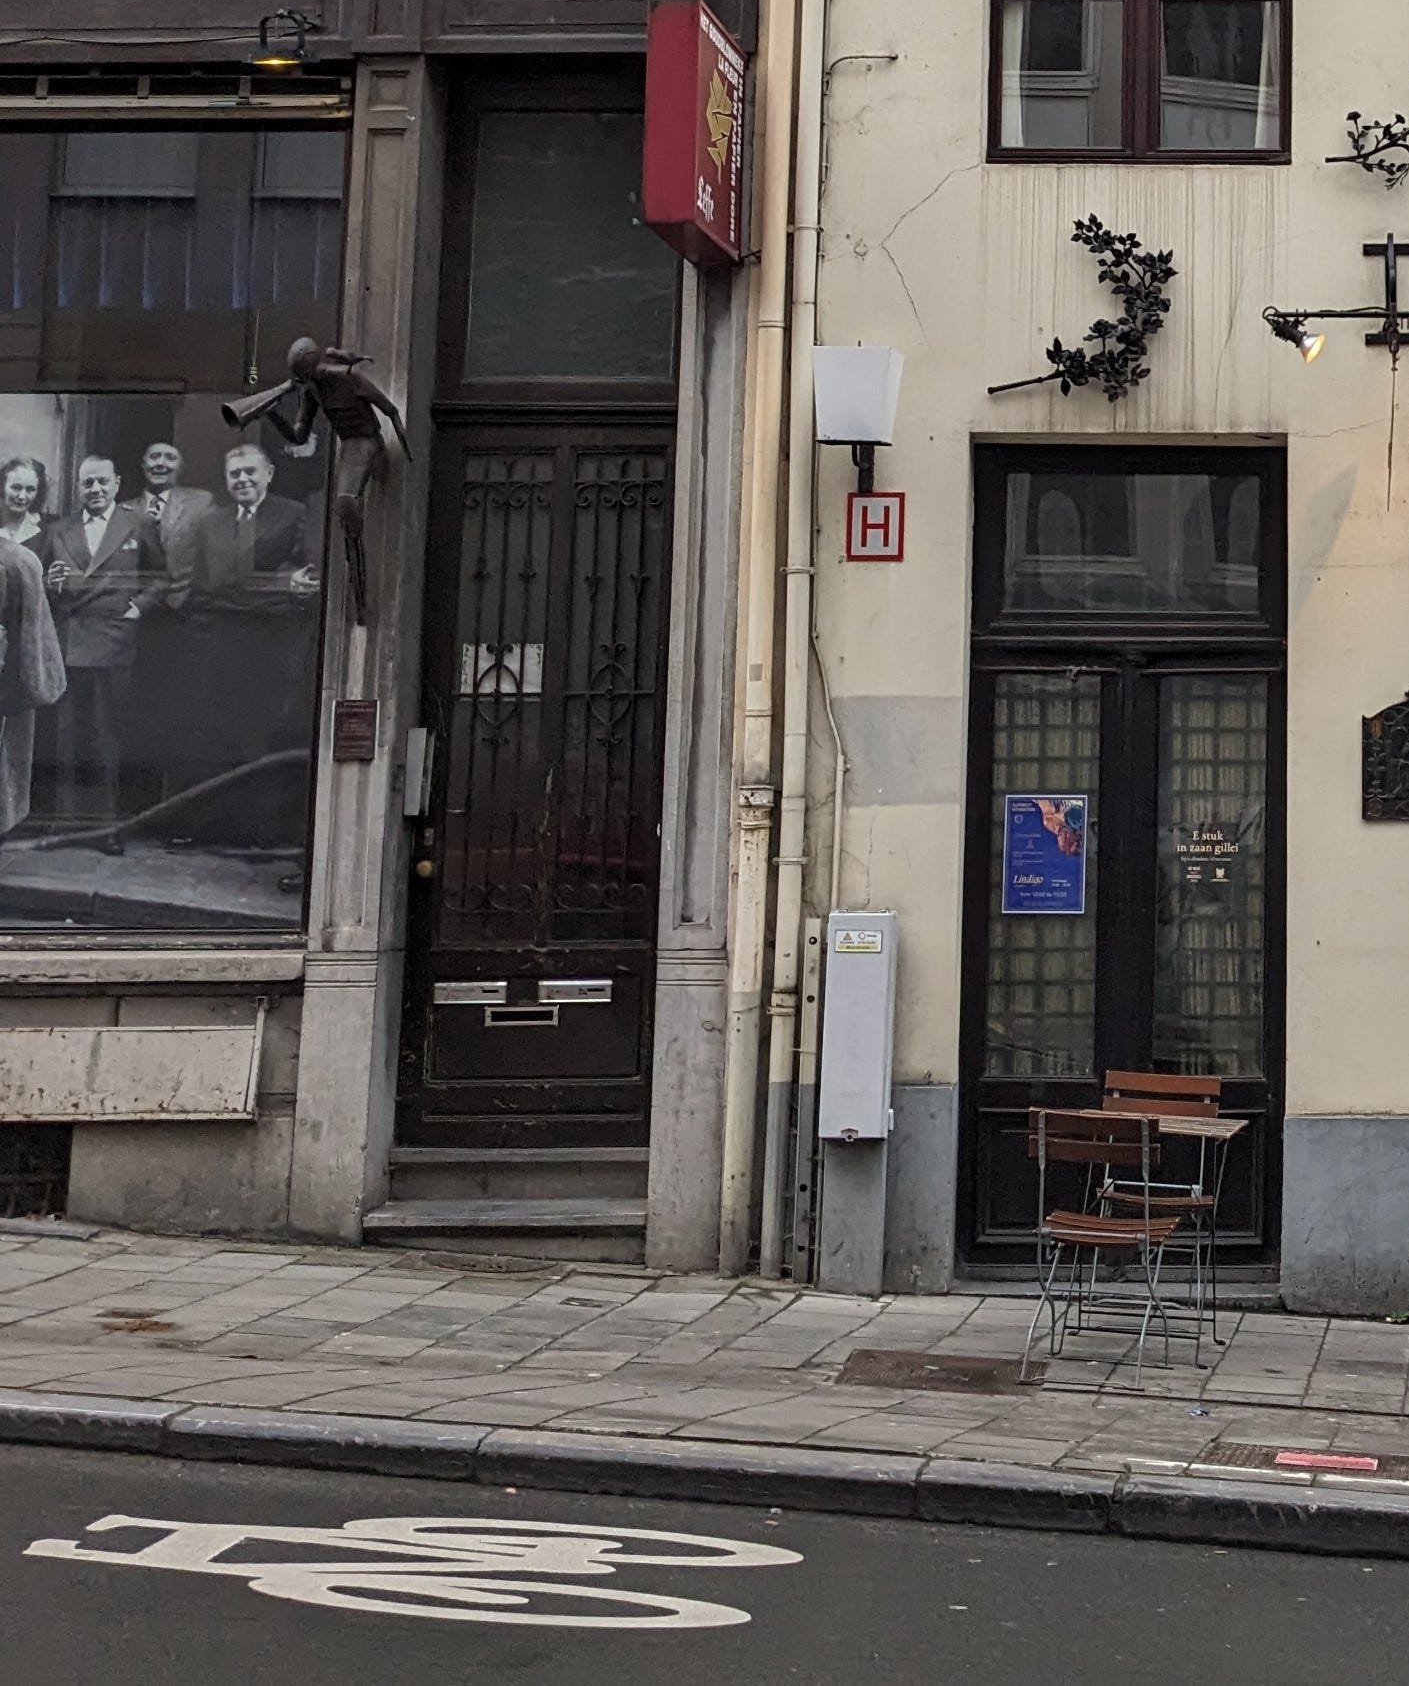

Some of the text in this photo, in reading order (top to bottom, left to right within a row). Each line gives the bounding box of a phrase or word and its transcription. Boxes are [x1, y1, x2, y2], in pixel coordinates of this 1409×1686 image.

[718, 54, 725, 73] LA
[861, 505, 890, 547] H
[1201, 830, 1224, 841] stuk
[1176, 843, 1187, 852] in
[1189, 844, 1213, 852] zaan
